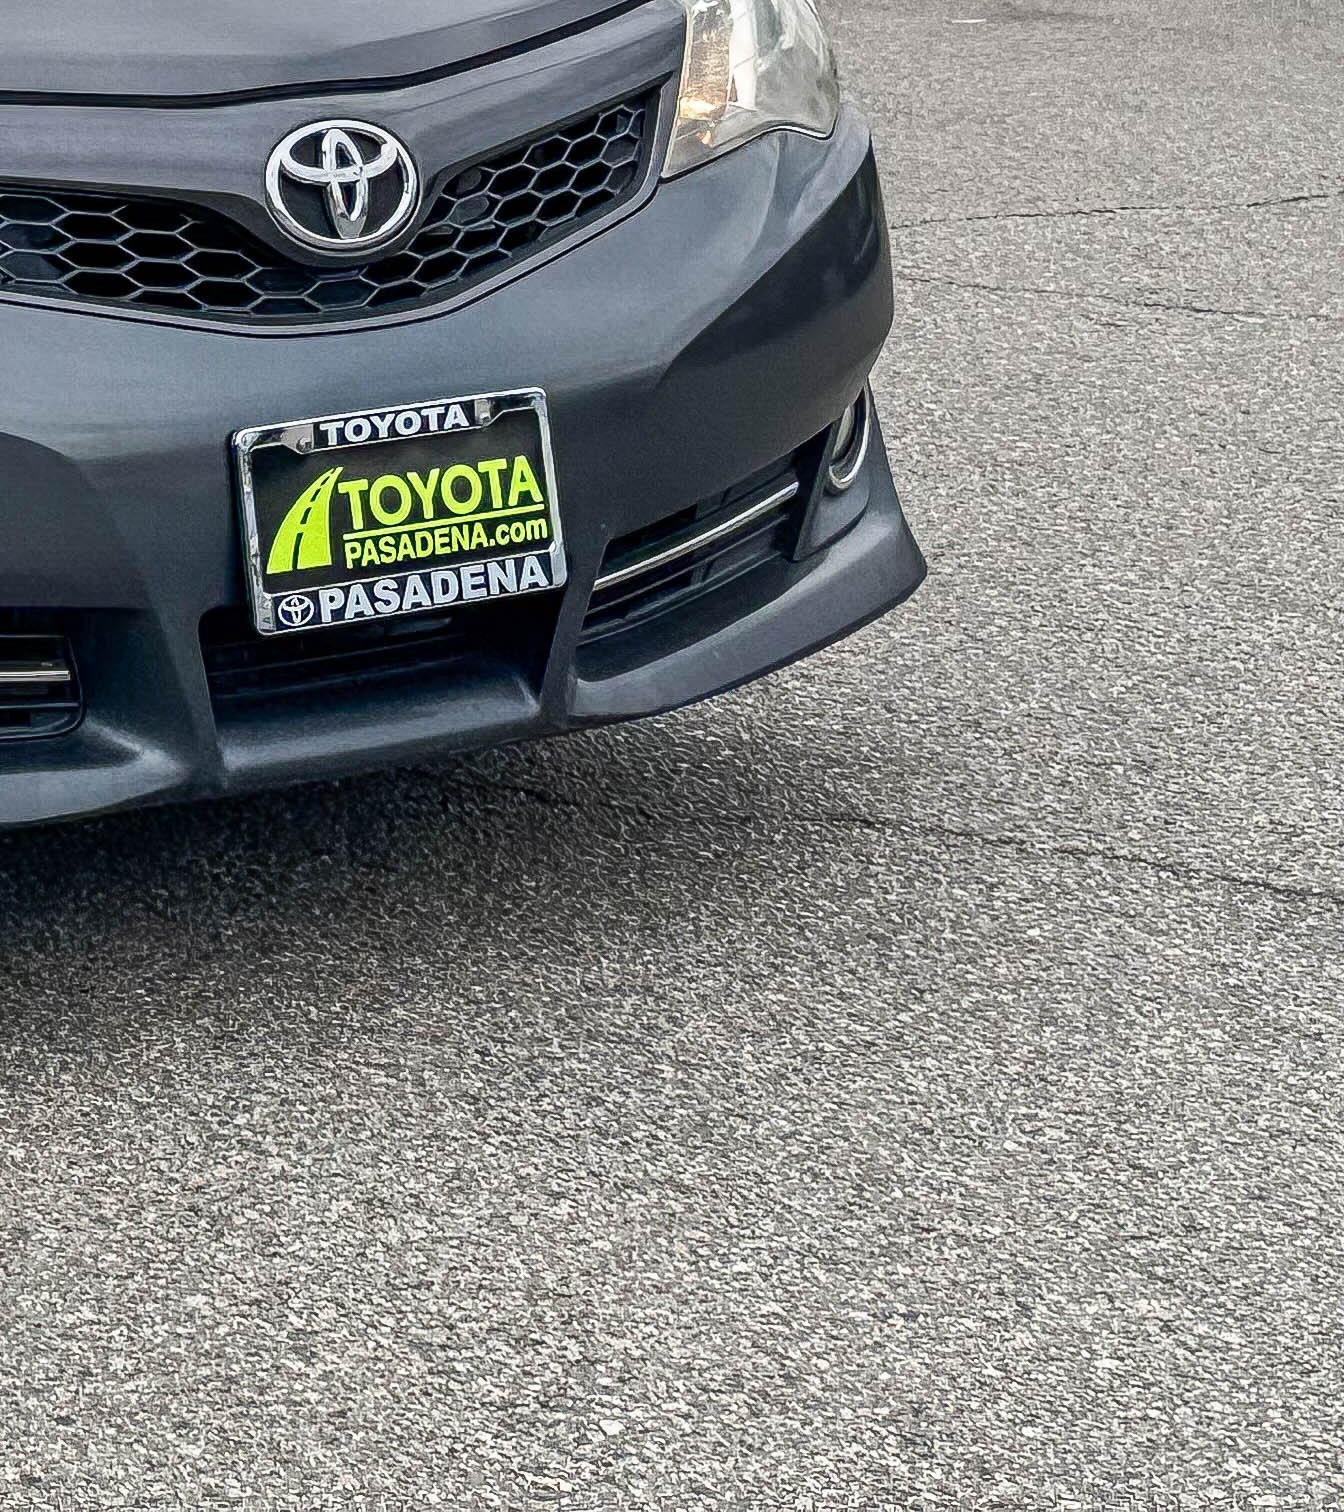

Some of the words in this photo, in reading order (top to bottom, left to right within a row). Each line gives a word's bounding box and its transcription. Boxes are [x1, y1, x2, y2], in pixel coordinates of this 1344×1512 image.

[319, 403, 470, 446] TOYOTA
[337, 454, 545, 531] TOYOTA
[343, 517, 548, 570] PASADENA.com
[318, 554, 550, 623] PASADENA
